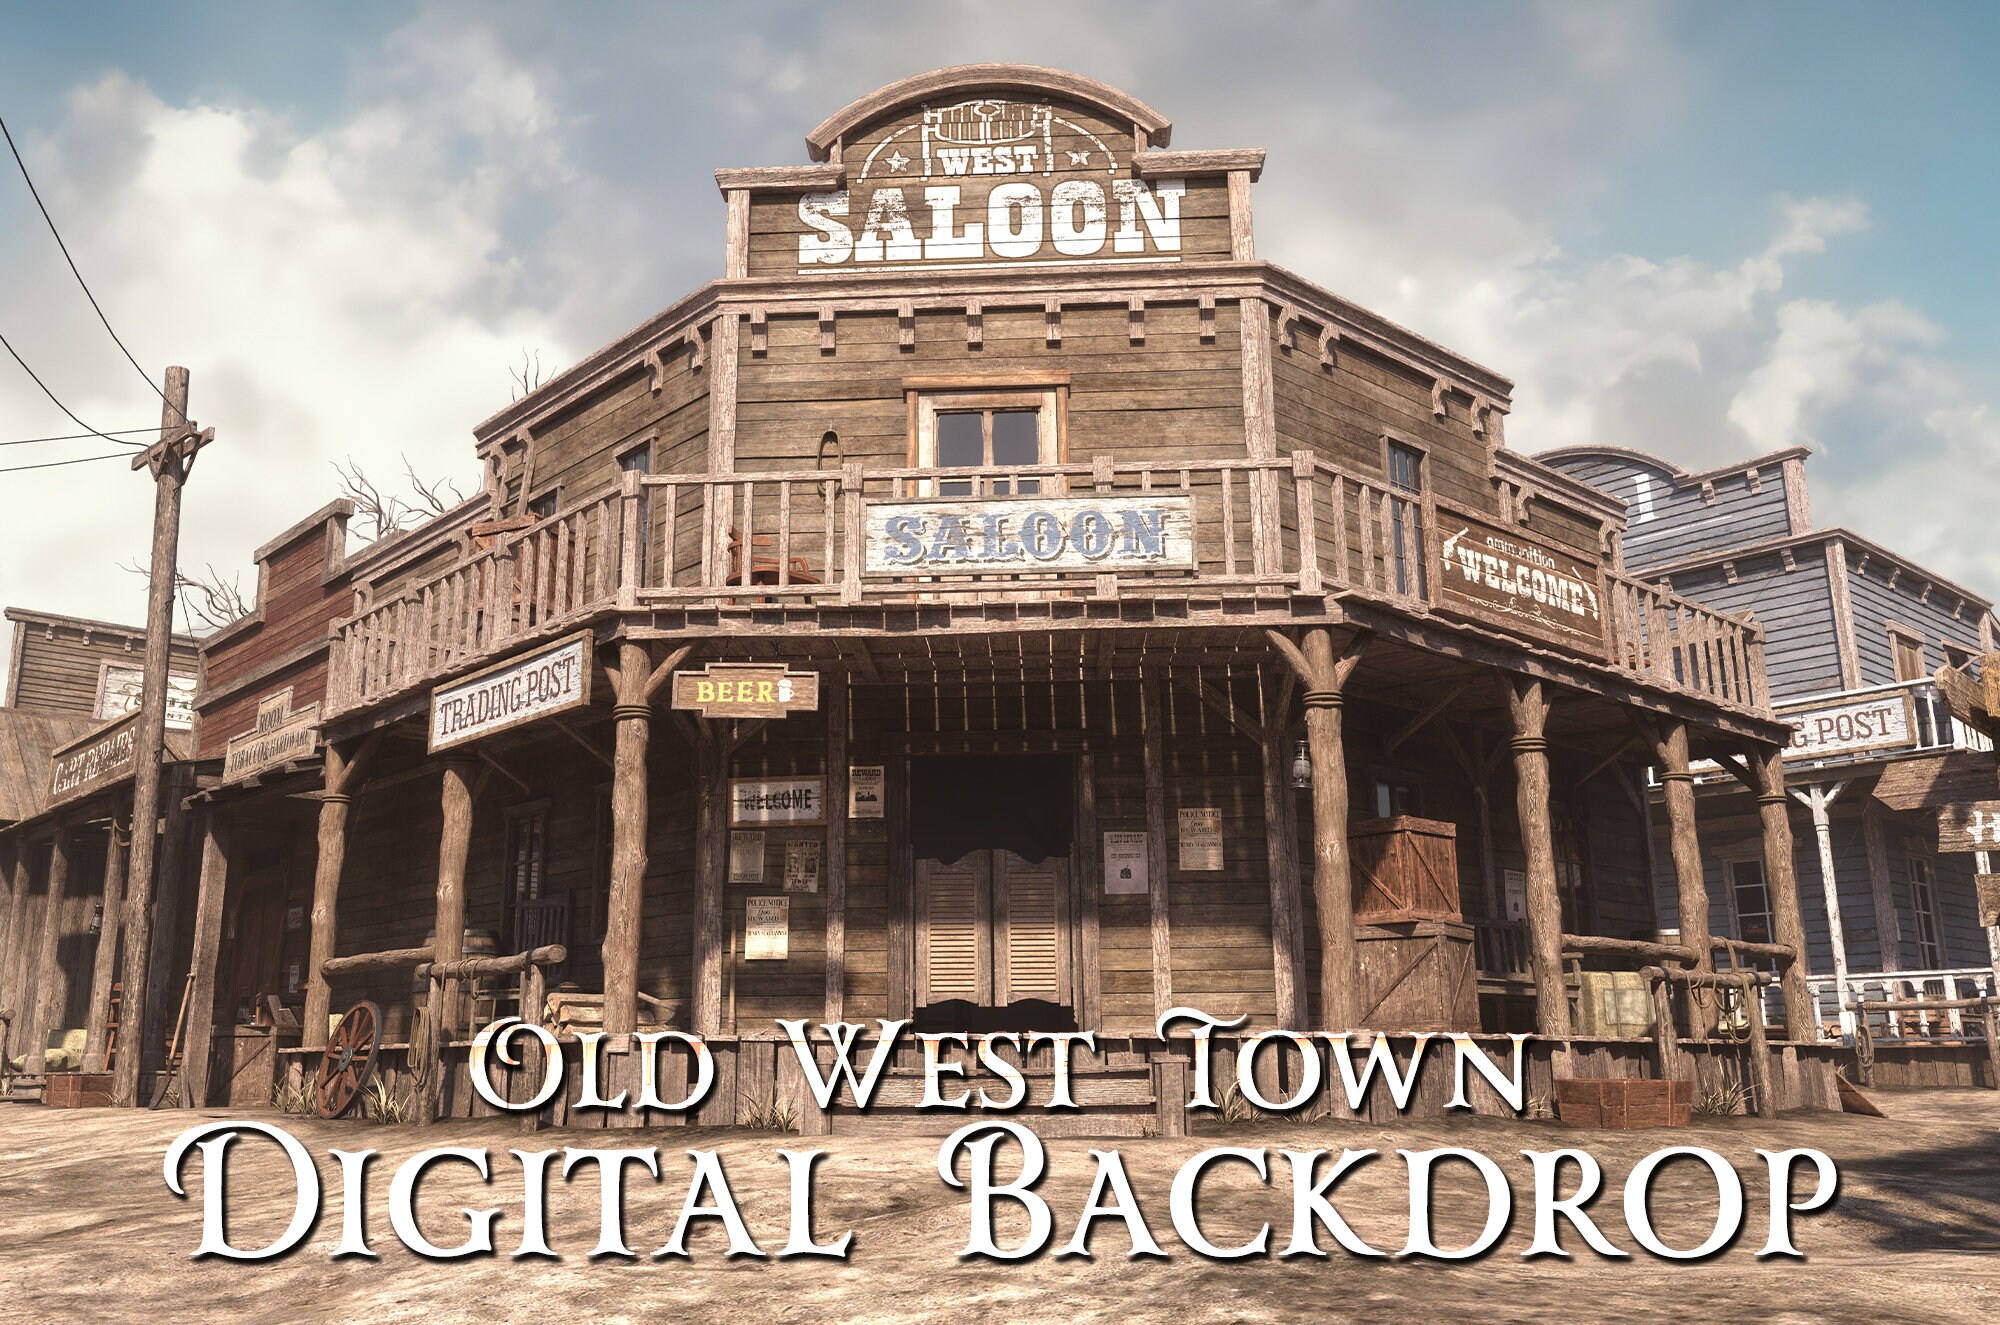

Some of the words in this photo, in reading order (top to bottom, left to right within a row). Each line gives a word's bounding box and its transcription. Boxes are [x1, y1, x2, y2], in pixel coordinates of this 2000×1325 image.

[936, 145, 1039, 176] WEST
[797, 178, 1187, 265] SALOON
[884, 509, 1171, 566] SALOON
[1457, 546, 1585, 617] WELCOME
[441, 676, 521, 736] TRADING
[526, 655, 576, 707] POST
[696, 681, 777, 703] BEER
[259, 706, 284, 733] ROOM
[1815, 708, 1892, 745] POST
[744, 788, 812, 811] WELCOME
